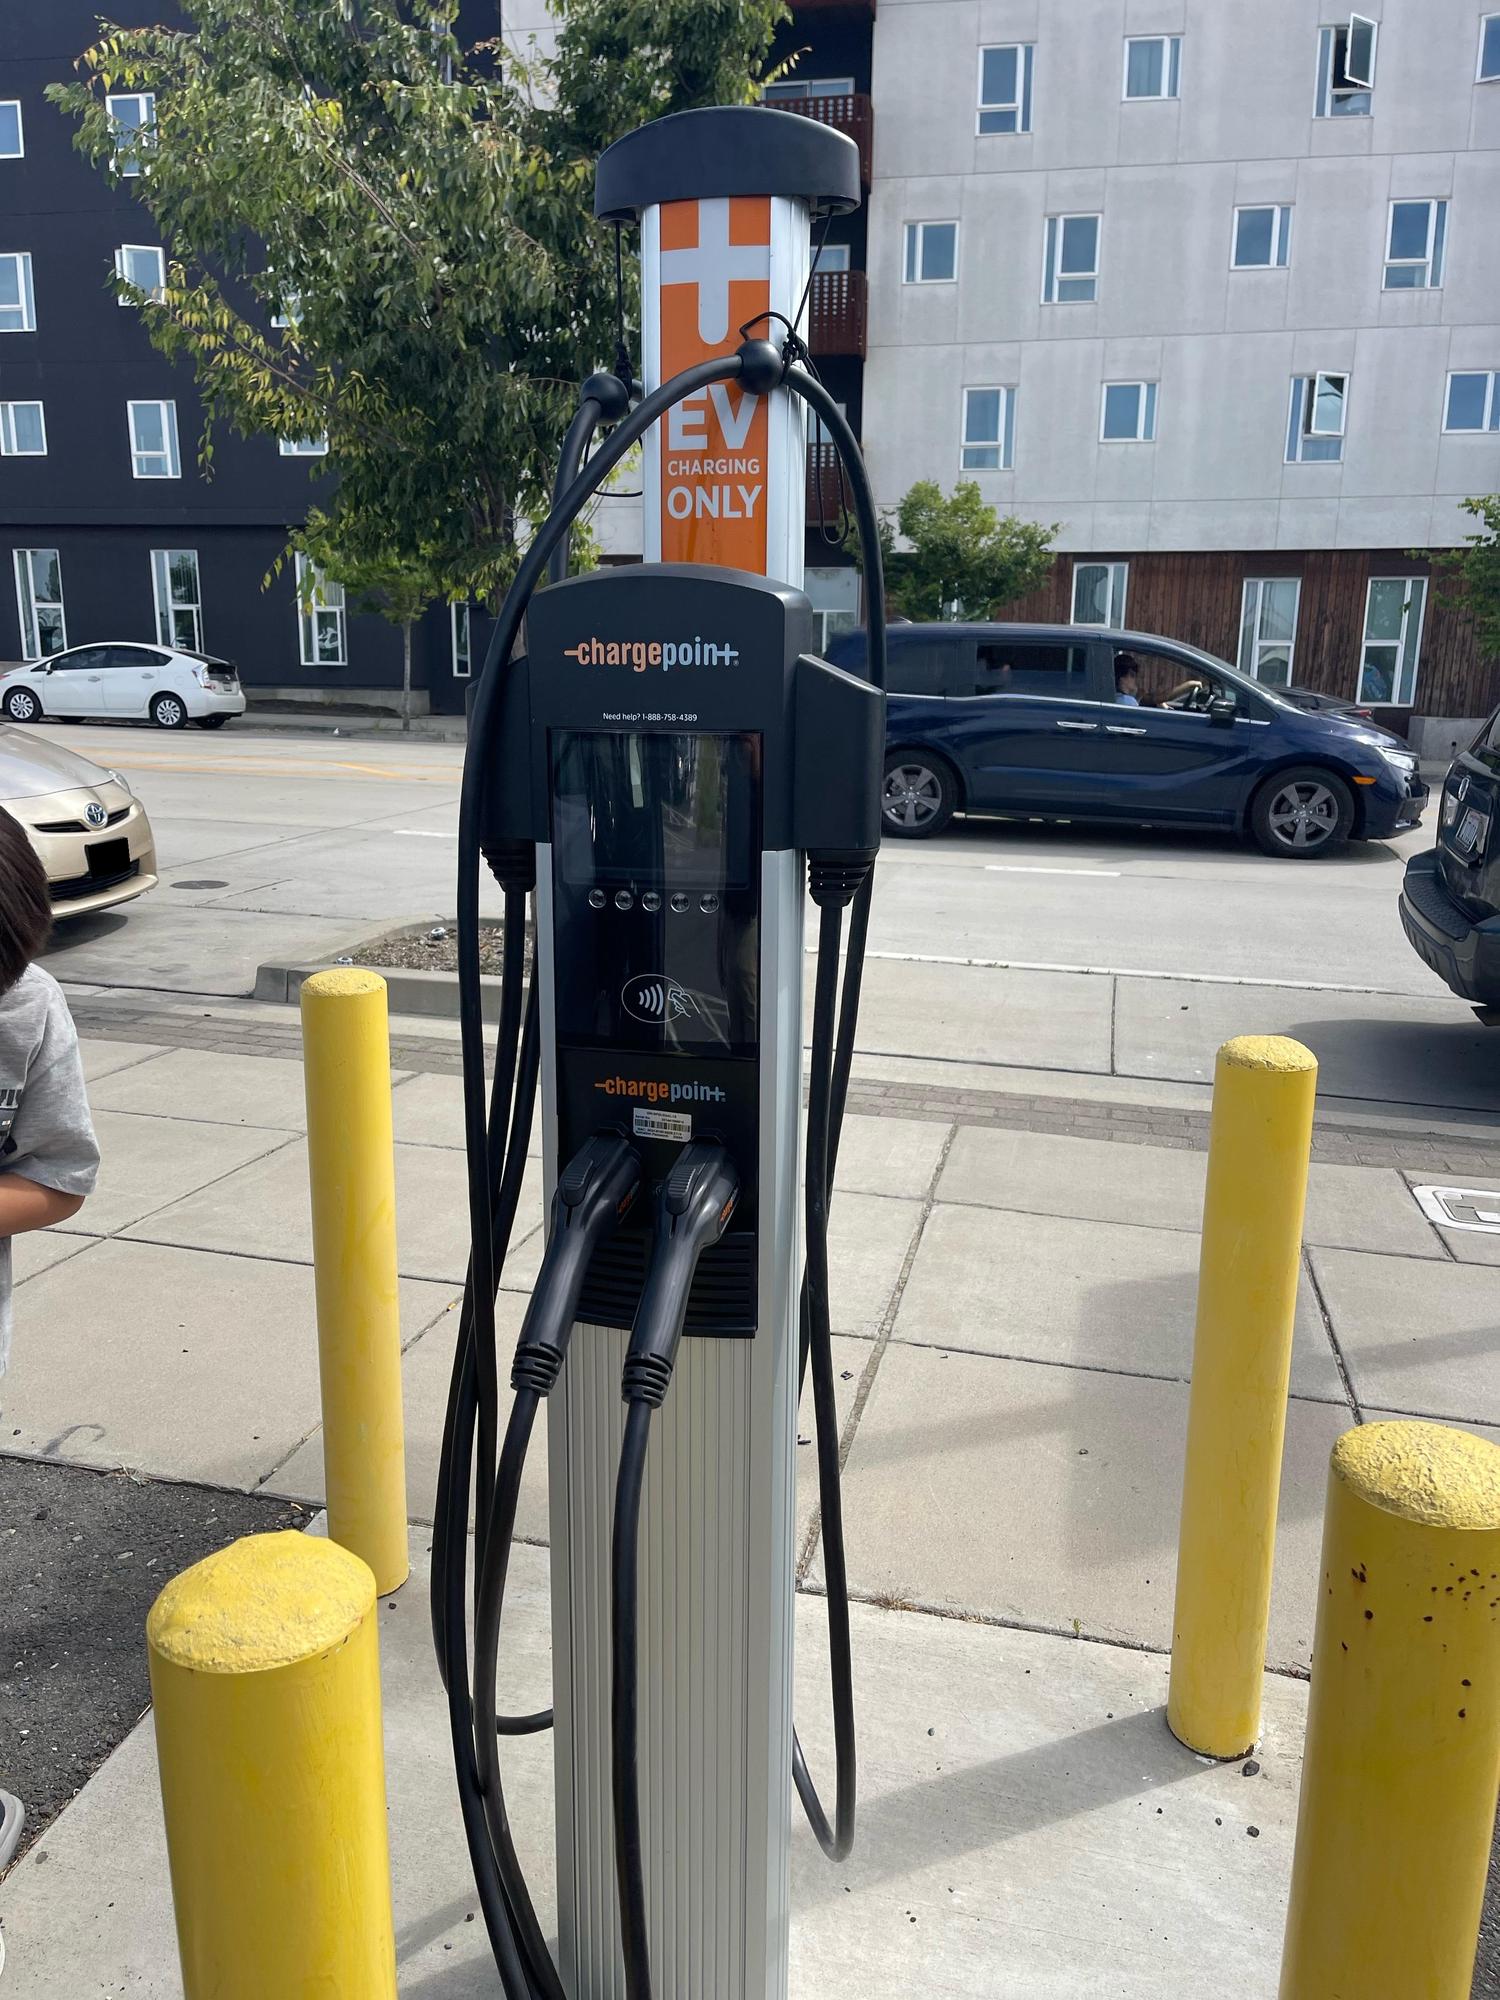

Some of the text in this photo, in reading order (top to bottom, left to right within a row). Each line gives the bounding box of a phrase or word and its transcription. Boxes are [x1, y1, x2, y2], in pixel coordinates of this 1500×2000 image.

[668, 384, 760, 450] EV
[667, 458, 760, 476] CHARGING
[667, 484, 763, 520] ONLY
[602, 712, 698, 722] Need help? 1-888-758-4389
